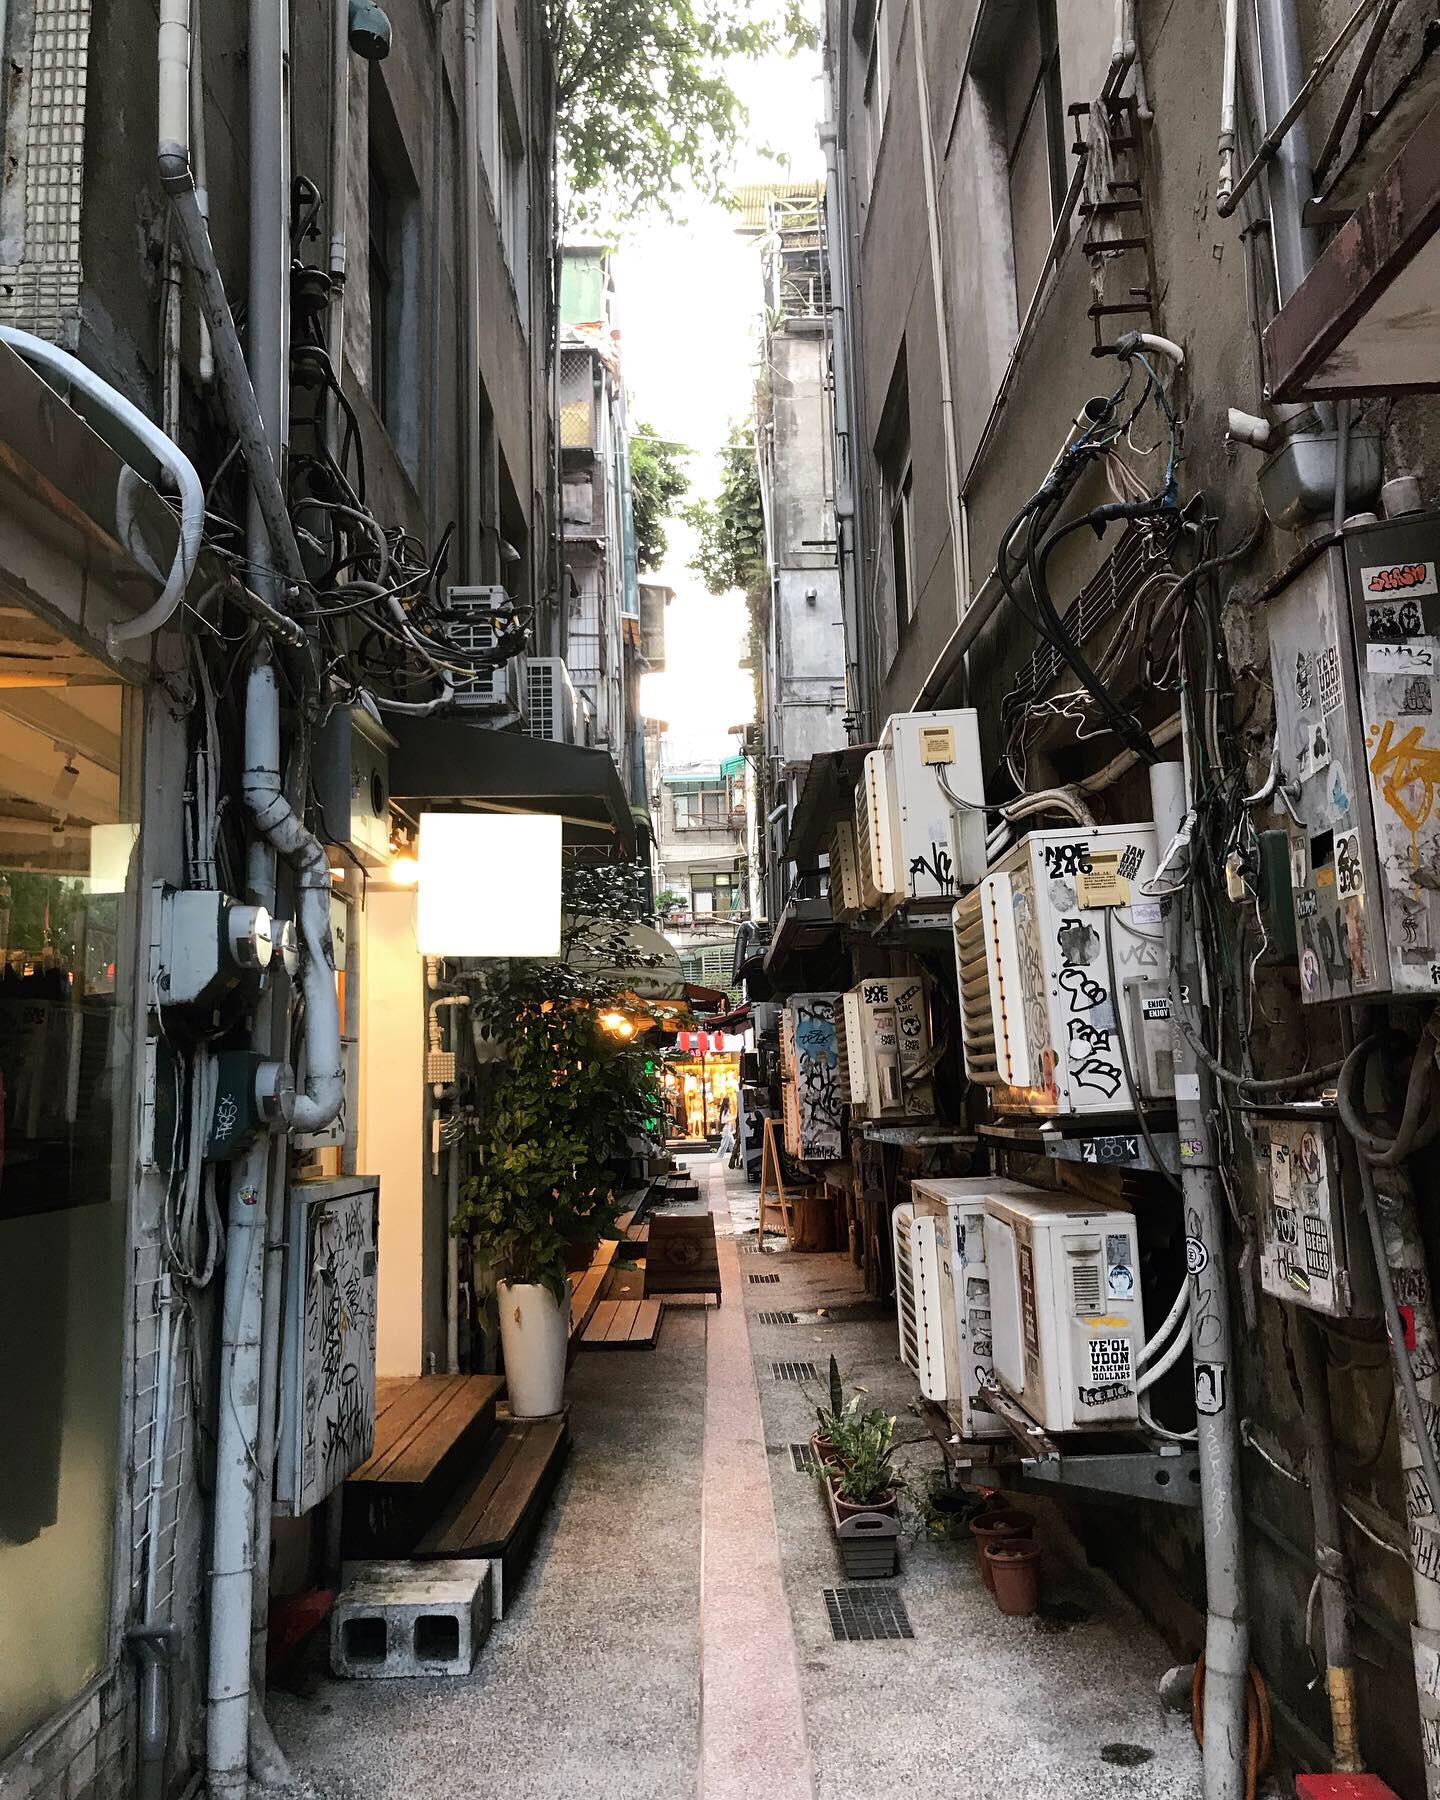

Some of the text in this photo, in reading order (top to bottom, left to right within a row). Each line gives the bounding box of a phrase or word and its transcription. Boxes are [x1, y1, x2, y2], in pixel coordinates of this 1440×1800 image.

[1050, 859, 1093, 879] 246
[1117, 868, 1136, 881] HERE
[866, 994, 888, 1004] 246
[1148, 1000, 1167, 1008] ENJOY
[1149, 1009, 1167, 1018] ENJOY
[1089, 1340, 1129, 1352] YE'OL
[1091, 1352, 1129, 1364] UDON
[1092, 1364, 1130, 1372] MAKING
[1093, 1371, 1130, 1381] DOLLARS
